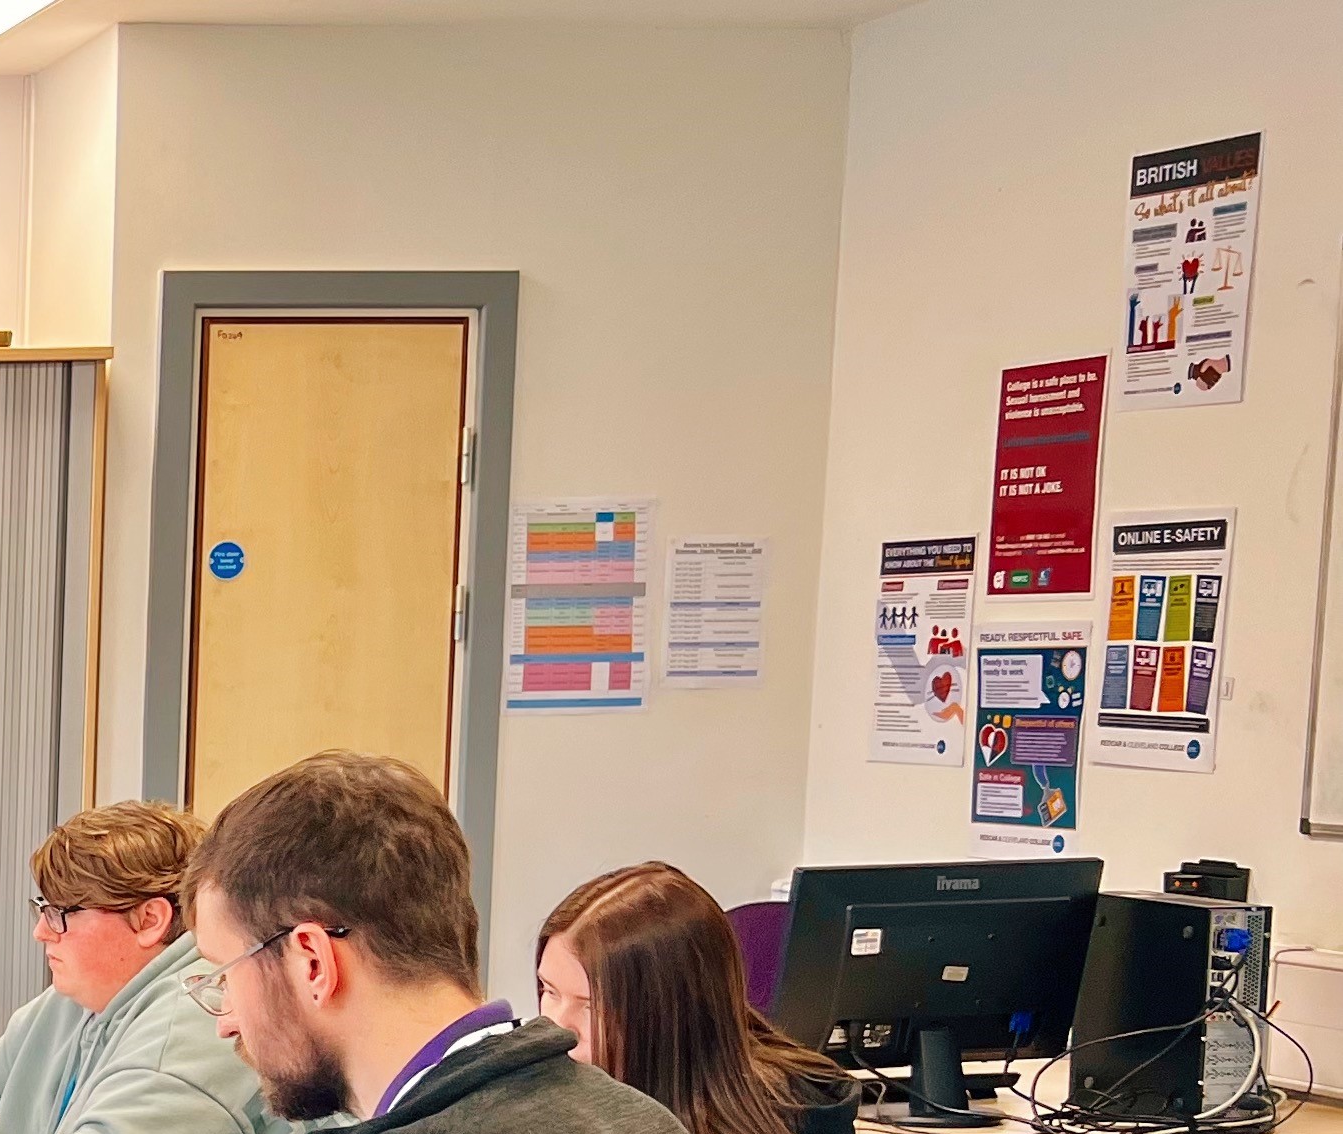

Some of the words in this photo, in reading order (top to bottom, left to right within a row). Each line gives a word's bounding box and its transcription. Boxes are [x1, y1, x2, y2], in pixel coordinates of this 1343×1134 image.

[1135, 158, 1198, 187] BRITISH
[1134, 202, 1150, 221] So
[1118, 530, 1161, 545] ONLINE
[1163, 526, 1221, 544] E-SAFETY
[885, 546, 927, 557] EVERYTHING
[927, 545, 942, 555] YOU
[980, 633, 1006, 642] READY.
[1008, 632, 1060, 641] RESPECTFUL.
[1061, 631, 1084, 640] SAFE.
